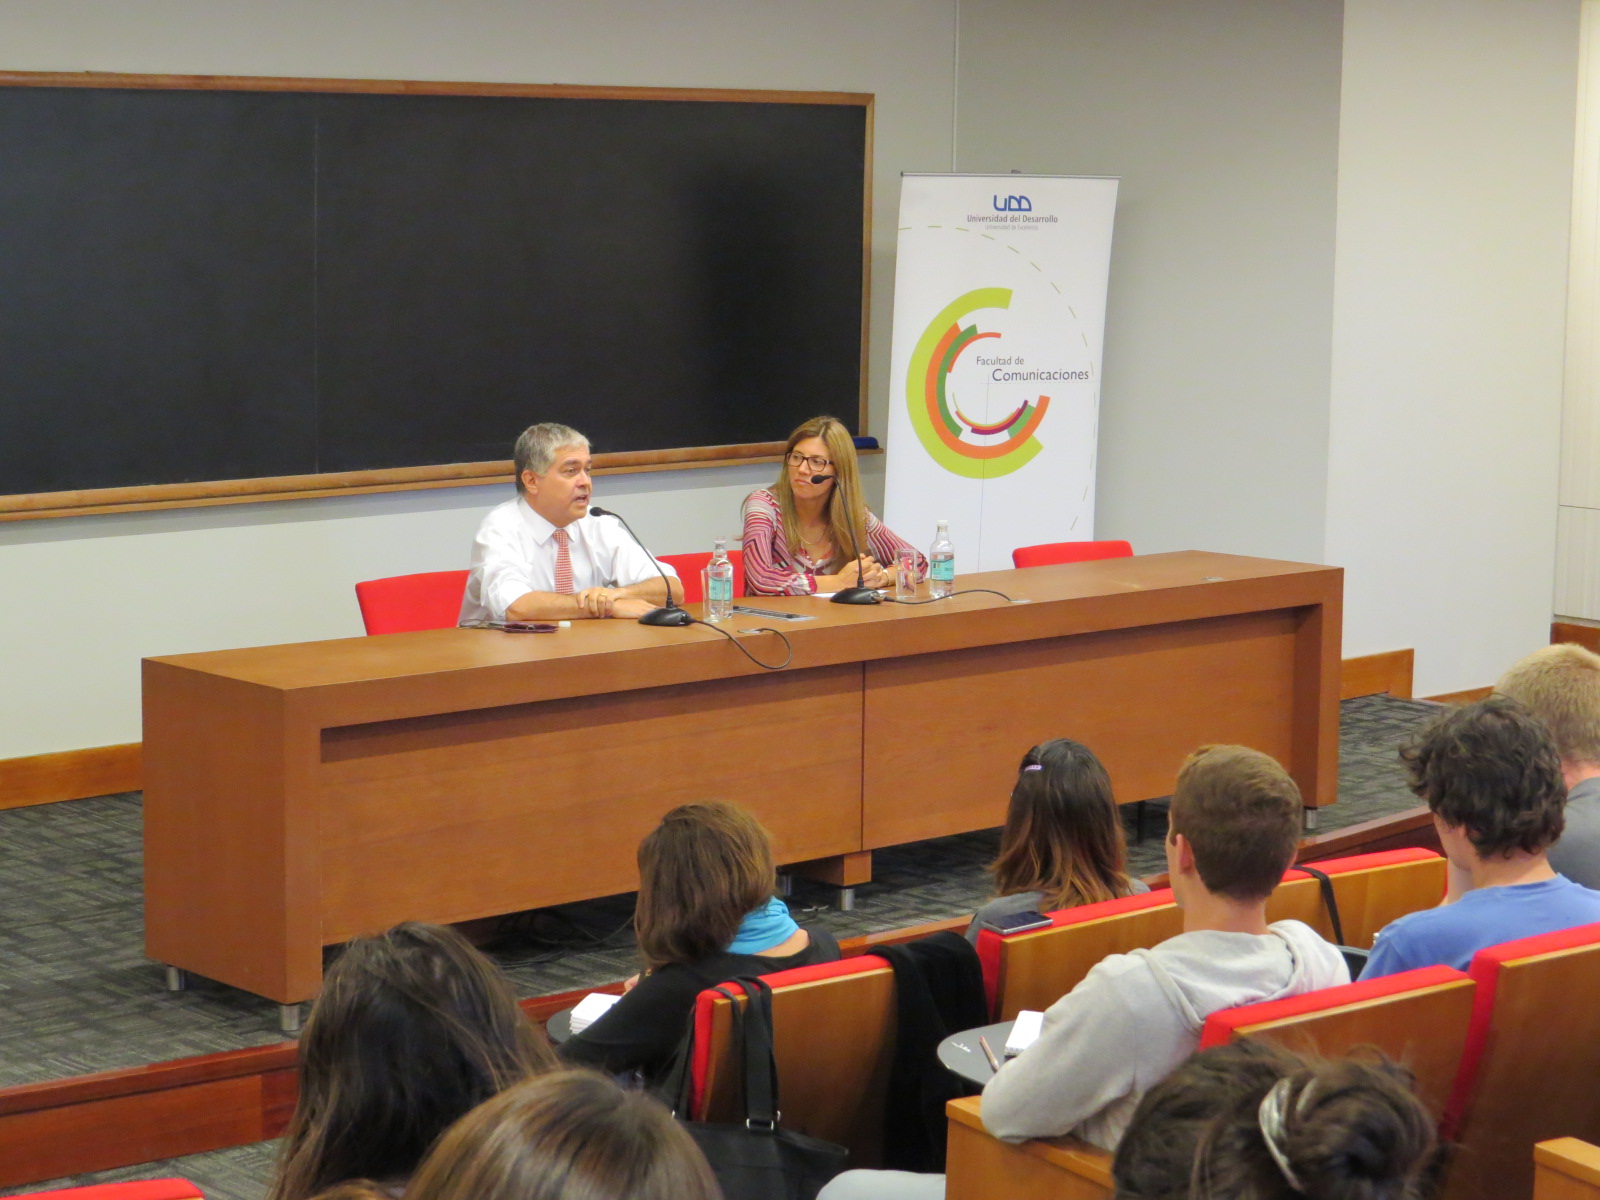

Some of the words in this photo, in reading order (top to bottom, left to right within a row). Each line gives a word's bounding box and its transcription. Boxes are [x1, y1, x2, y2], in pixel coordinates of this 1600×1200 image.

[967, 214, 1008, 223] Universidad
[1010, 214, 1021, 223] del
[1022, 214, 1058, 223] Desarrollo
[976, 356, 1012, 366] Facultad
[1014, 356, 1025, 365] de
[992, 368, 1089, 381] Comunicaciones
